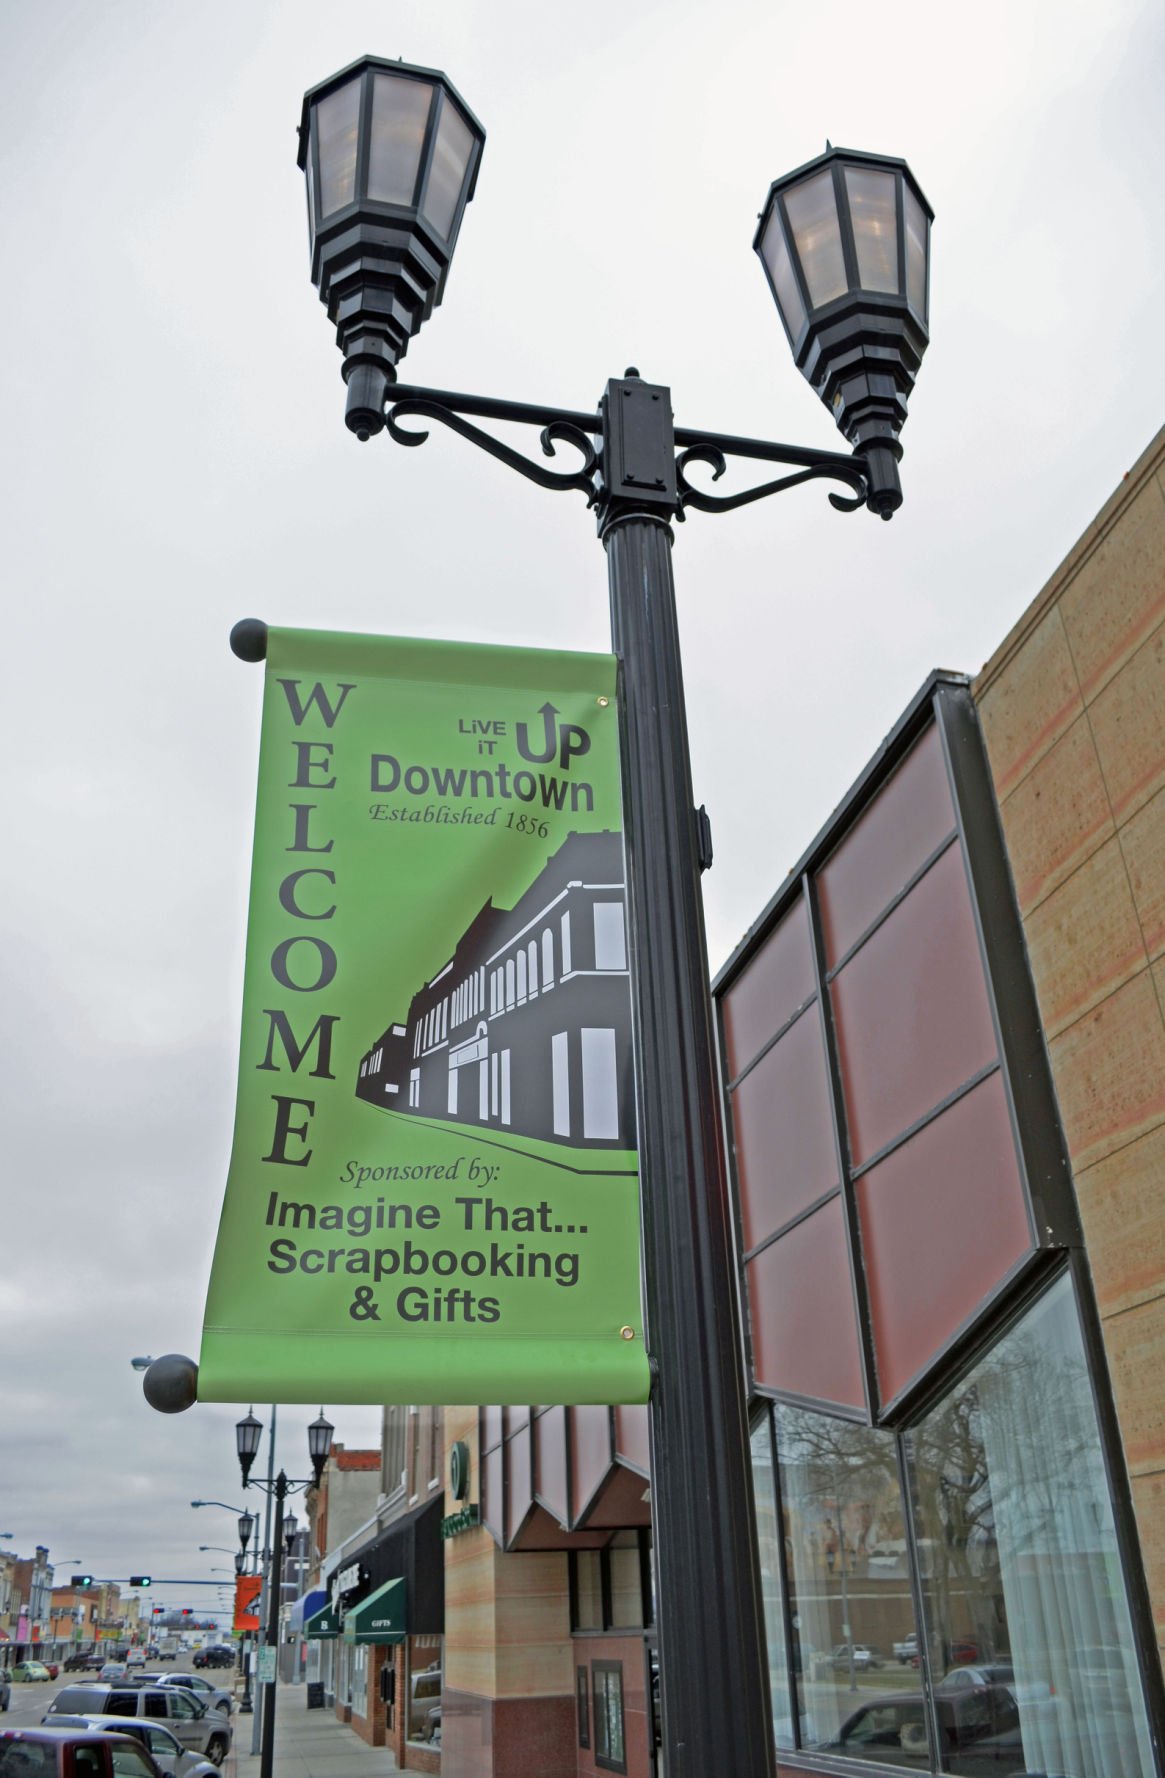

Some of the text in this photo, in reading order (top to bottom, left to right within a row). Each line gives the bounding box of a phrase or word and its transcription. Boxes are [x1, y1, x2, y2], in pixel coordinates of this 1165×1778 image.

[516, 702, 591, 770] UP
[371, 753, 594, 812] Downtown
[369, 804, 549, 838] Established 1856
[255, 678, 357, 1167] WELCOME
[340, 1158, 500, 1188] Sponsored by:
[265, 1192, 588, 1236] Imagine That...
[267, 1239, 579, 1287] Scrapbooking
[349, 1286, 501, 1323] & Gifts
[371, 1619, 391, 1628] GIFTS
